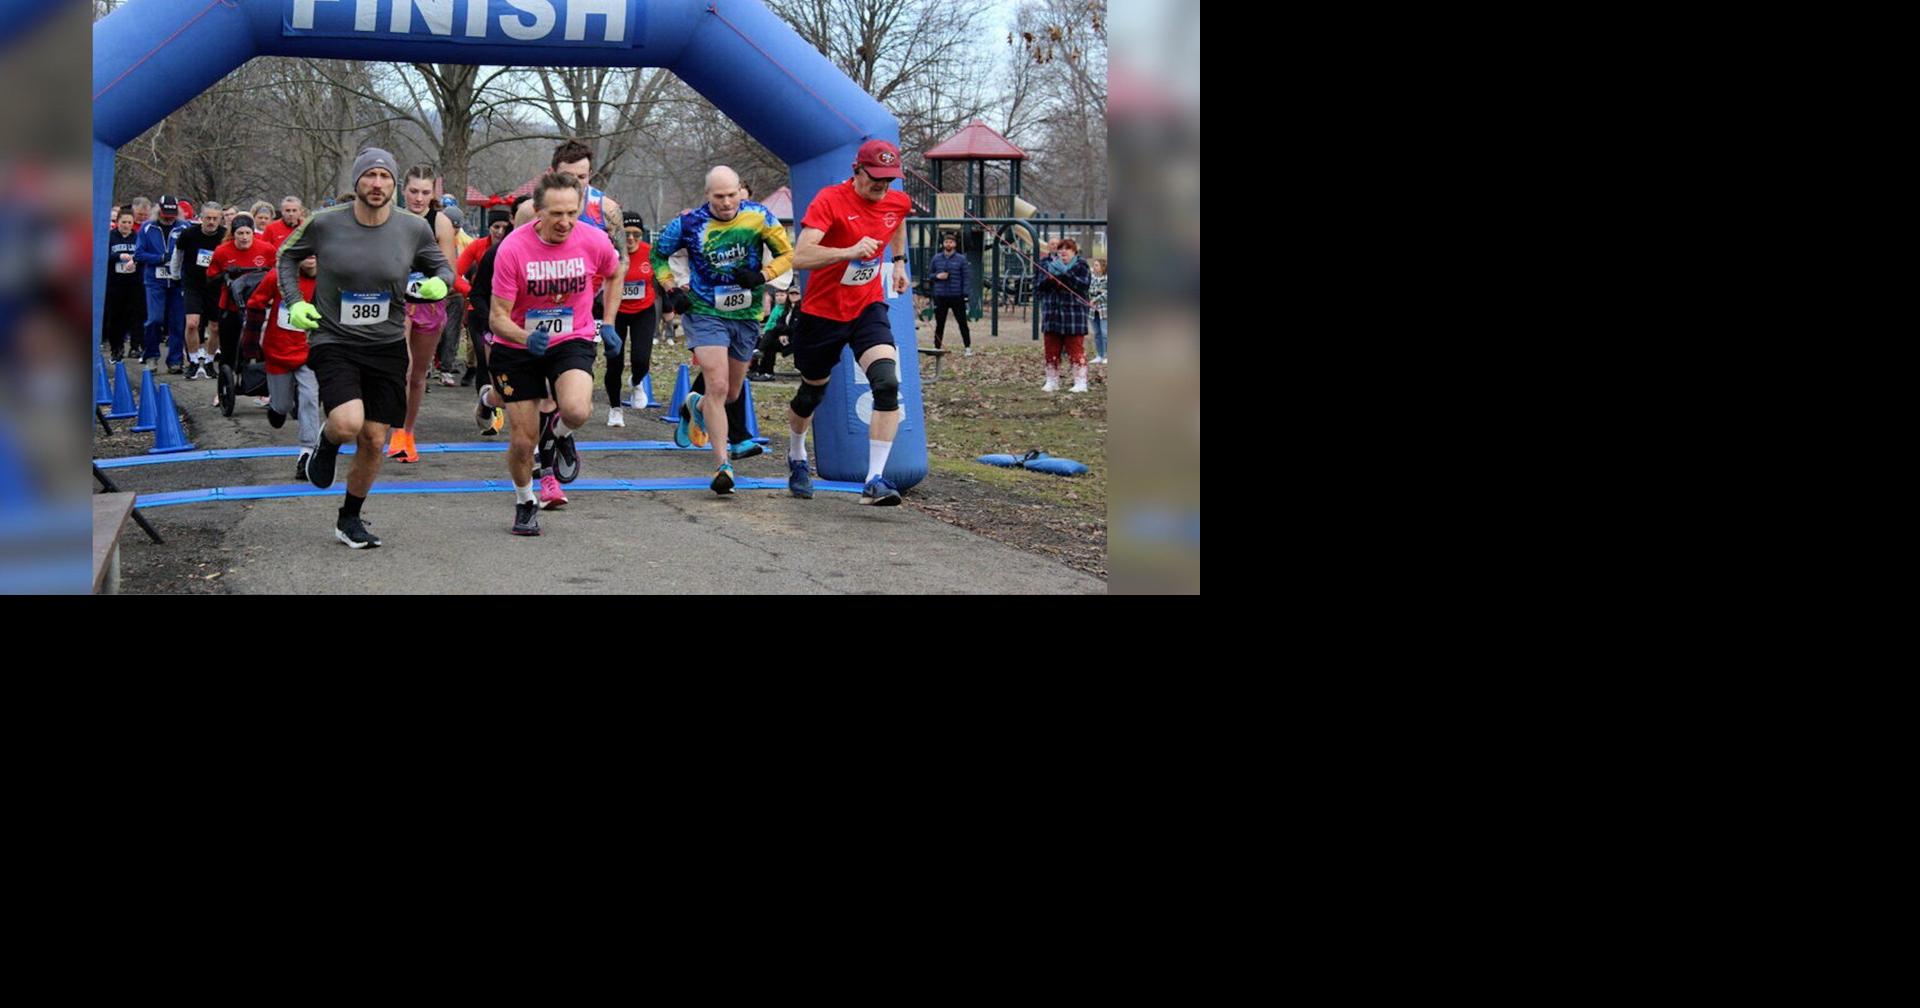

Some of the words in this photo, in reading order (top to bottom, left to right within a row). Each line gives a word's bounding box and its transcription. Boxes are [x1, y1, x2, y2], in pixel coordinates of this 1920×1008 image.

[526, 257, 585, 280] SUNDAY
[852, 268, 874, 281] 253
[526, 275, 586, 296] RUNDAY
[723, 293, 745, 307] 483
[352, 303, 380, 319] 389
